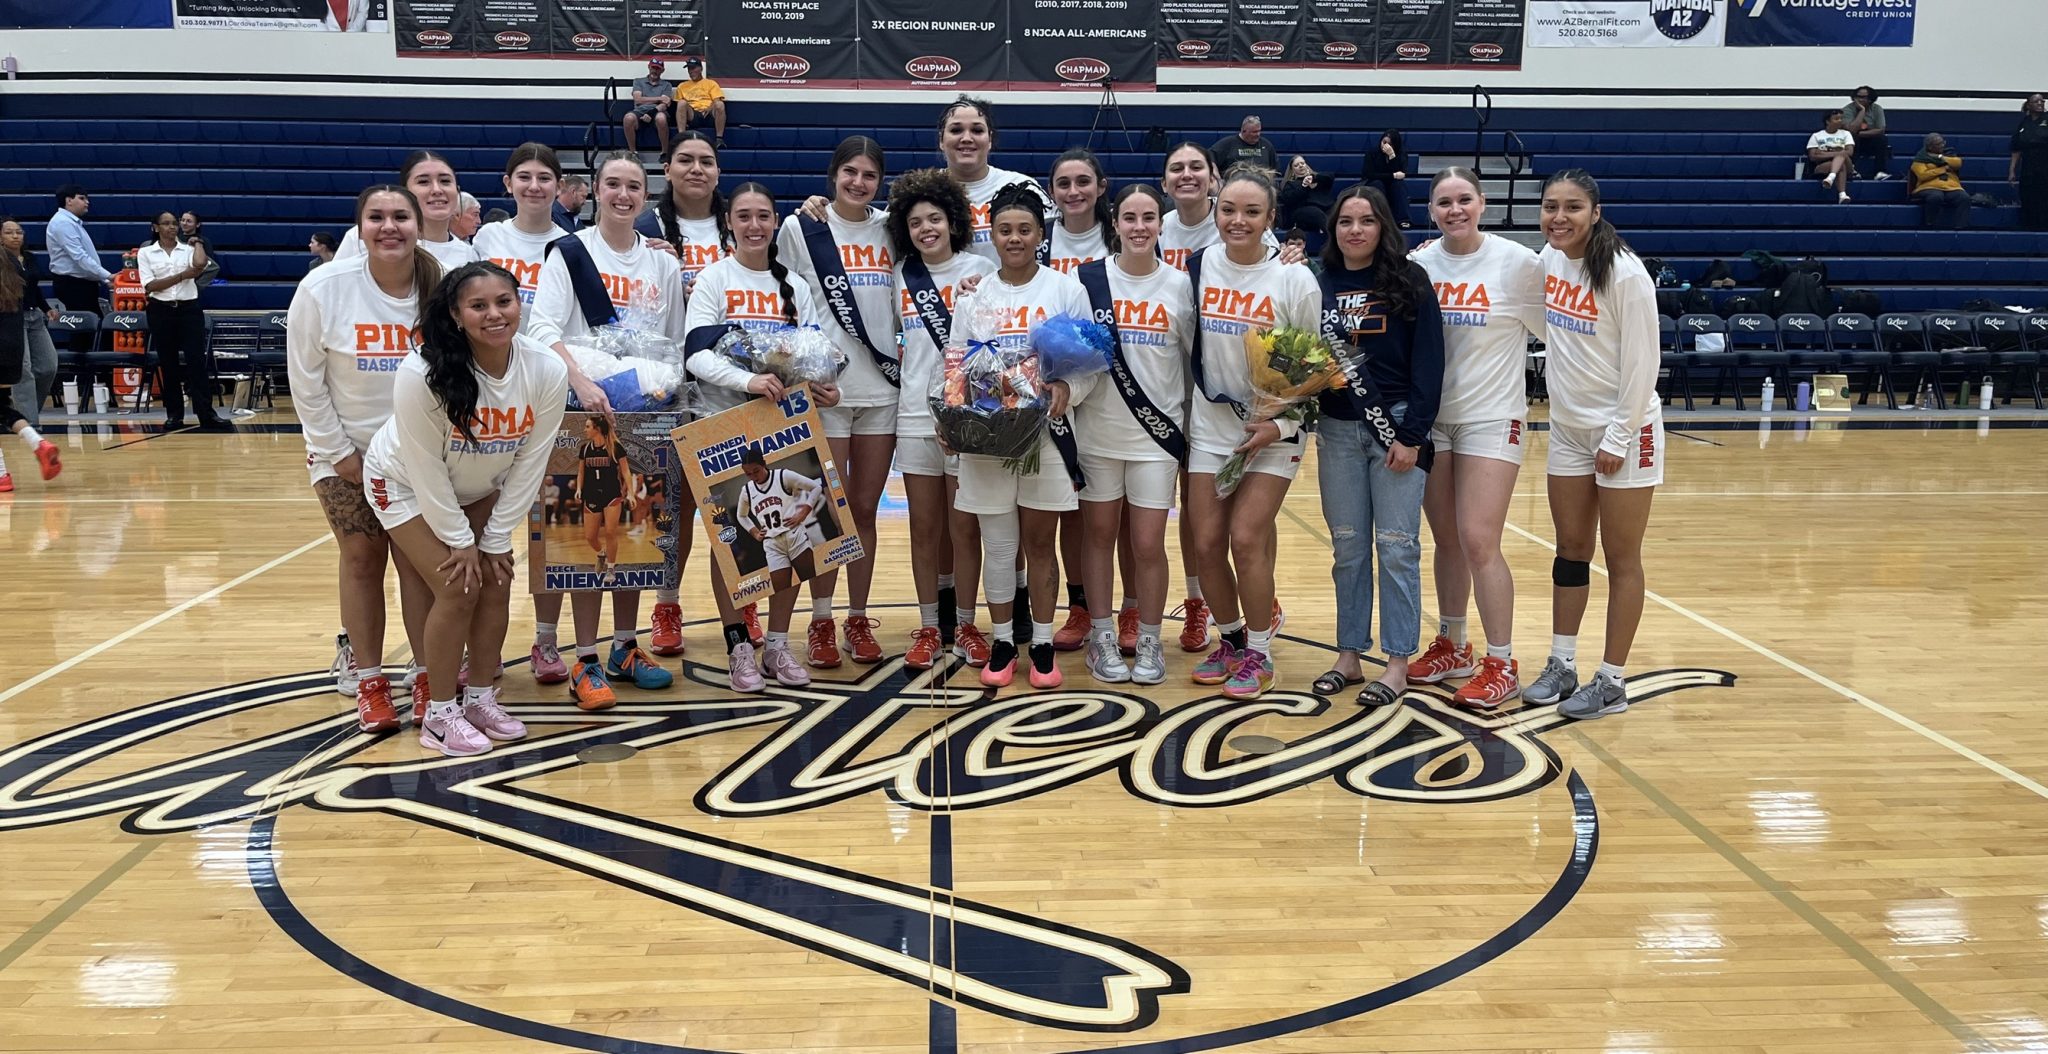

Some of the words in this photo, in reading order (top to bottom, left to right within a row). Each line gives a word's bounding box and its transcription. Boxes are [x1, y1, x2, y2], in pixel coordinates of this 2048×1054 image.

[742, 2, 771, 10] NJCAA
[773, 2, 790, 10] 5TH
[792, 2, 819, 10] PLACE
[1035, 1, 1059, 9] (2010,
[1061, 1, 1081, 9] 2017,
[1083, 1, 1104, 9] 2018,
[1105, 1, 1127, 9] 2019)
[1651, 0, 1713, 14] MAMBA
[1779, 0, 1863, 10] Vantage
[1865, 0, 1912, 8] West
[761, 12, 784, 21] 2010,
[785, 12, 805, 20] 2019
[1537, 17, 1641, 26] www.AZBernalFit.com
[1670, 10, 1692, 27] AZ
[872, 21, 886, 30] 3X
[888, 21, 929, 30] REGION
[931, 21, 996, 31] RUNNER-UP
[1024, 29, 1031, 37] 8
[1032, 29, 1065, 37] NJCAA
[1067, 29, 1147, 38] ALL-AMERICANS
[1558, 28, 1618, 38] 520.820.5168
[732, 36, 740, 44] 11
[771, 37, 831, 45] All-Americans
[758, 62, 806, 71] CHAPMAN
[909, 63, 957, 72] CHAPMAN
[1060, 65, 1106, 74] CHAPMAN
[836, 244, 894, 268] IMA
[129, 271, 136, 280] G
[725, 289, 800, 316] PIM
[1336, 293, 1368, 309] THE
[1433, 282, 1490, 307] IMA
[1545, 274, 1598, 315] PIMA
[1201, 287, 1276, 321] PIMA
[1112, 299, 1169, 328] IMA
[355, 323, 425, 351] PIM
[777, 389, 810, 420] 13
[1135, 405, 1174, 440] 2025
[1365, 406, 1396, 447] 202
[553, 437, 580, 449] ASTY
[697, 434, 747, 460] KENNEDI
[699, 421, 814, 478] NIEMANN
[1639, 423, 1653, 469] PIMA
[653, 446, 669, 470] 1
[371, 477, 393, 511] PIMA
[754, 496, 783, 514] AZTECS
[763, 511, 782, 530] 13
[840, 535, 858, 545] PIMA
[824, 545, 863, 566] BASKETBALL
[546, 565, 576, 573] REECE
[545, 570, 665, 590] NIEMANN
[732, 579, 771, 602] DYNASTY
